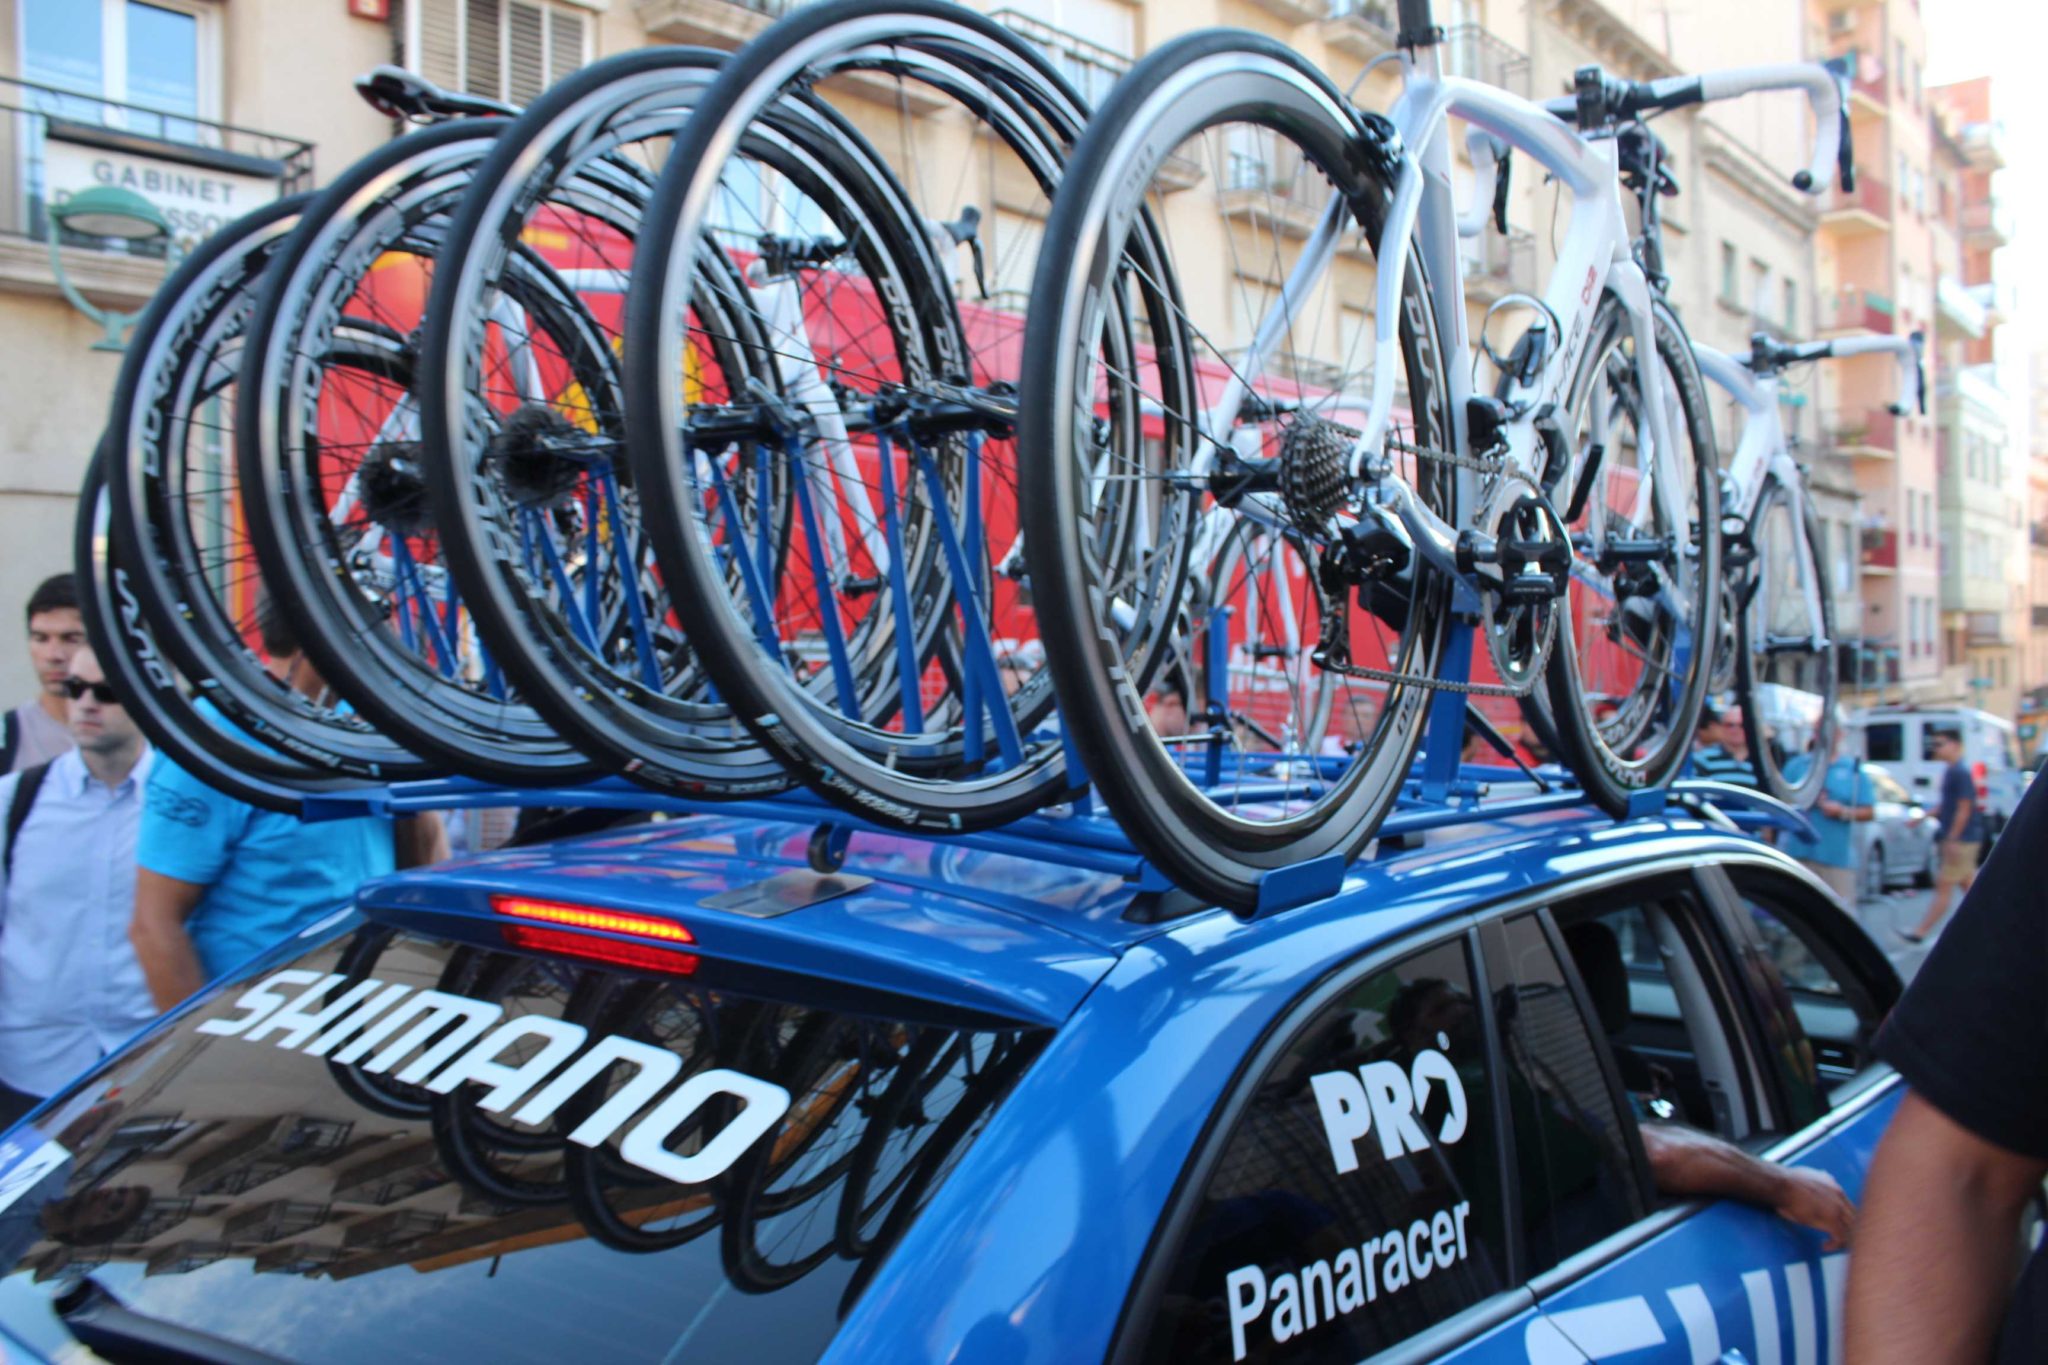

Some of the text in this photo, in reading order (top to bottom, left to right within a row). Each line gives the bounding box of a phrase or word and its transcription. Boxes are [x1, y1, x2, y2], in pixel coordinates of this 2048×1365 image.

[93, 160, 236, 205] GABINET
[197, 968, 791, 1185] SHIMANO
[1310, 1047, 1468, 1175] PRO
[1226, 1201, 1470, 1362] Panaracer
